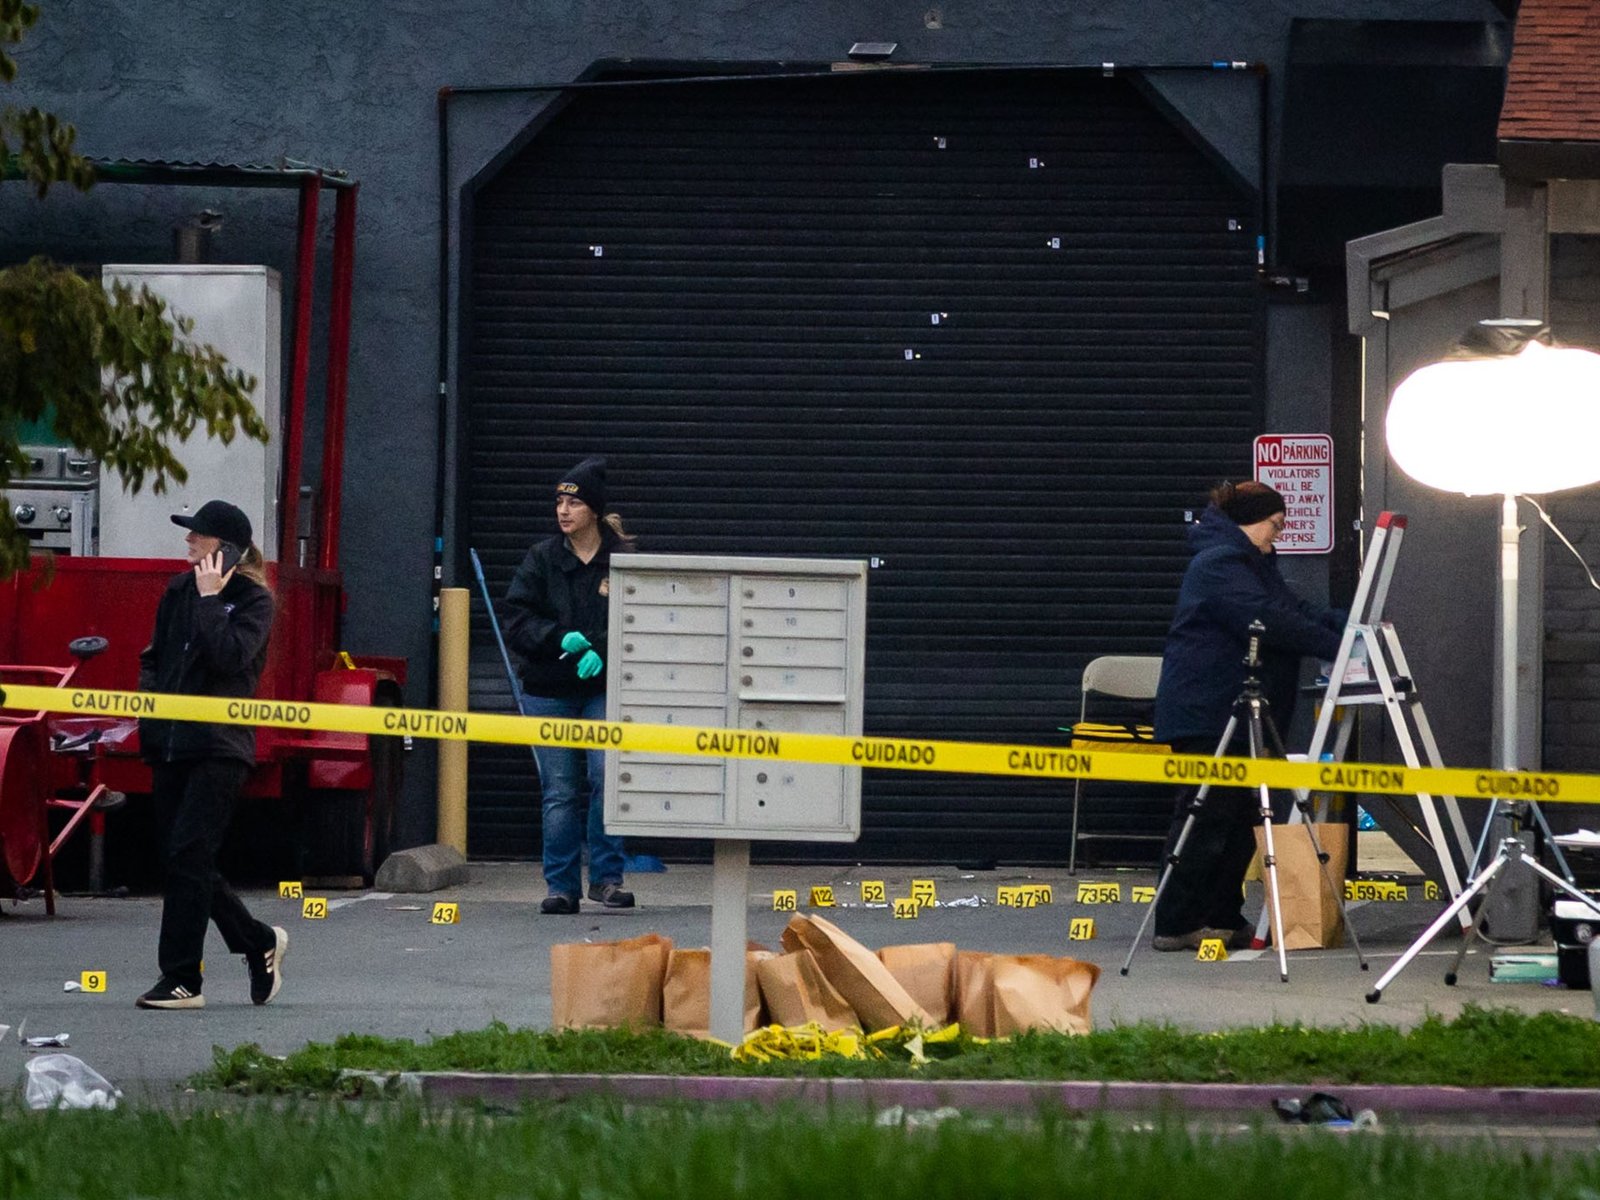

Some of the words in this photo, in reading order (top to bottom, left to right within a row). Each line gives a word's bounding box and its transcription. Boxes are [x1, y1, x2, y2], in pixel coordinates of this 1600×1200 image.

[1258, 443, 1280, 462] NO
[1283, 445, 1328, 460] PARKING
[1268, 469, 1320, 478] VIOLATORS
[1274, 482, 1297, 491] WILL
[1301, 482, 1313, 491] BE
[1298, 495, 1325, 503] AWAY
[71, 692, 156, 713] CAUTION
[228, 702, 311, 723] CUIDADO
[383, 712, 468, 734] CAUTION
[540, 722, 623, 745] CUIDADO
[696, 732, 780, 755] CAUTION
[852, 742, 936, 765] CUIDADO
[1008, 751, 1092, 773] CAUTION
[1164, 760, 1247, 782] CUIDADO
[1320, 768, 1404, 790] CAUTION
[1475, 775, 1560, 796] CUIDADO
[282, 885, 301, 899] 45
[815, 890, 834, 902] 122
[864, 887, 883, 900] 52
[1015, 892, 1033, 906] 47
[1080, 888, 1098, 904] 73
[1099, 888, 1118, 903] 56
[1358, 885, 1376, 900] 59
[1386, 891, 1405, 901] 65
[775, 895, 794, 910] 46
[915, 893, 932, 907] 57
[304, 902, 324, 917] 42
[433, 907, 454, 923] 43
[896, 904, 915, 918] 44
[1070, 923, 1089, 939] 41
[1200, 944, 1216, 960] 36
[88, 975, 99, 989] 9
